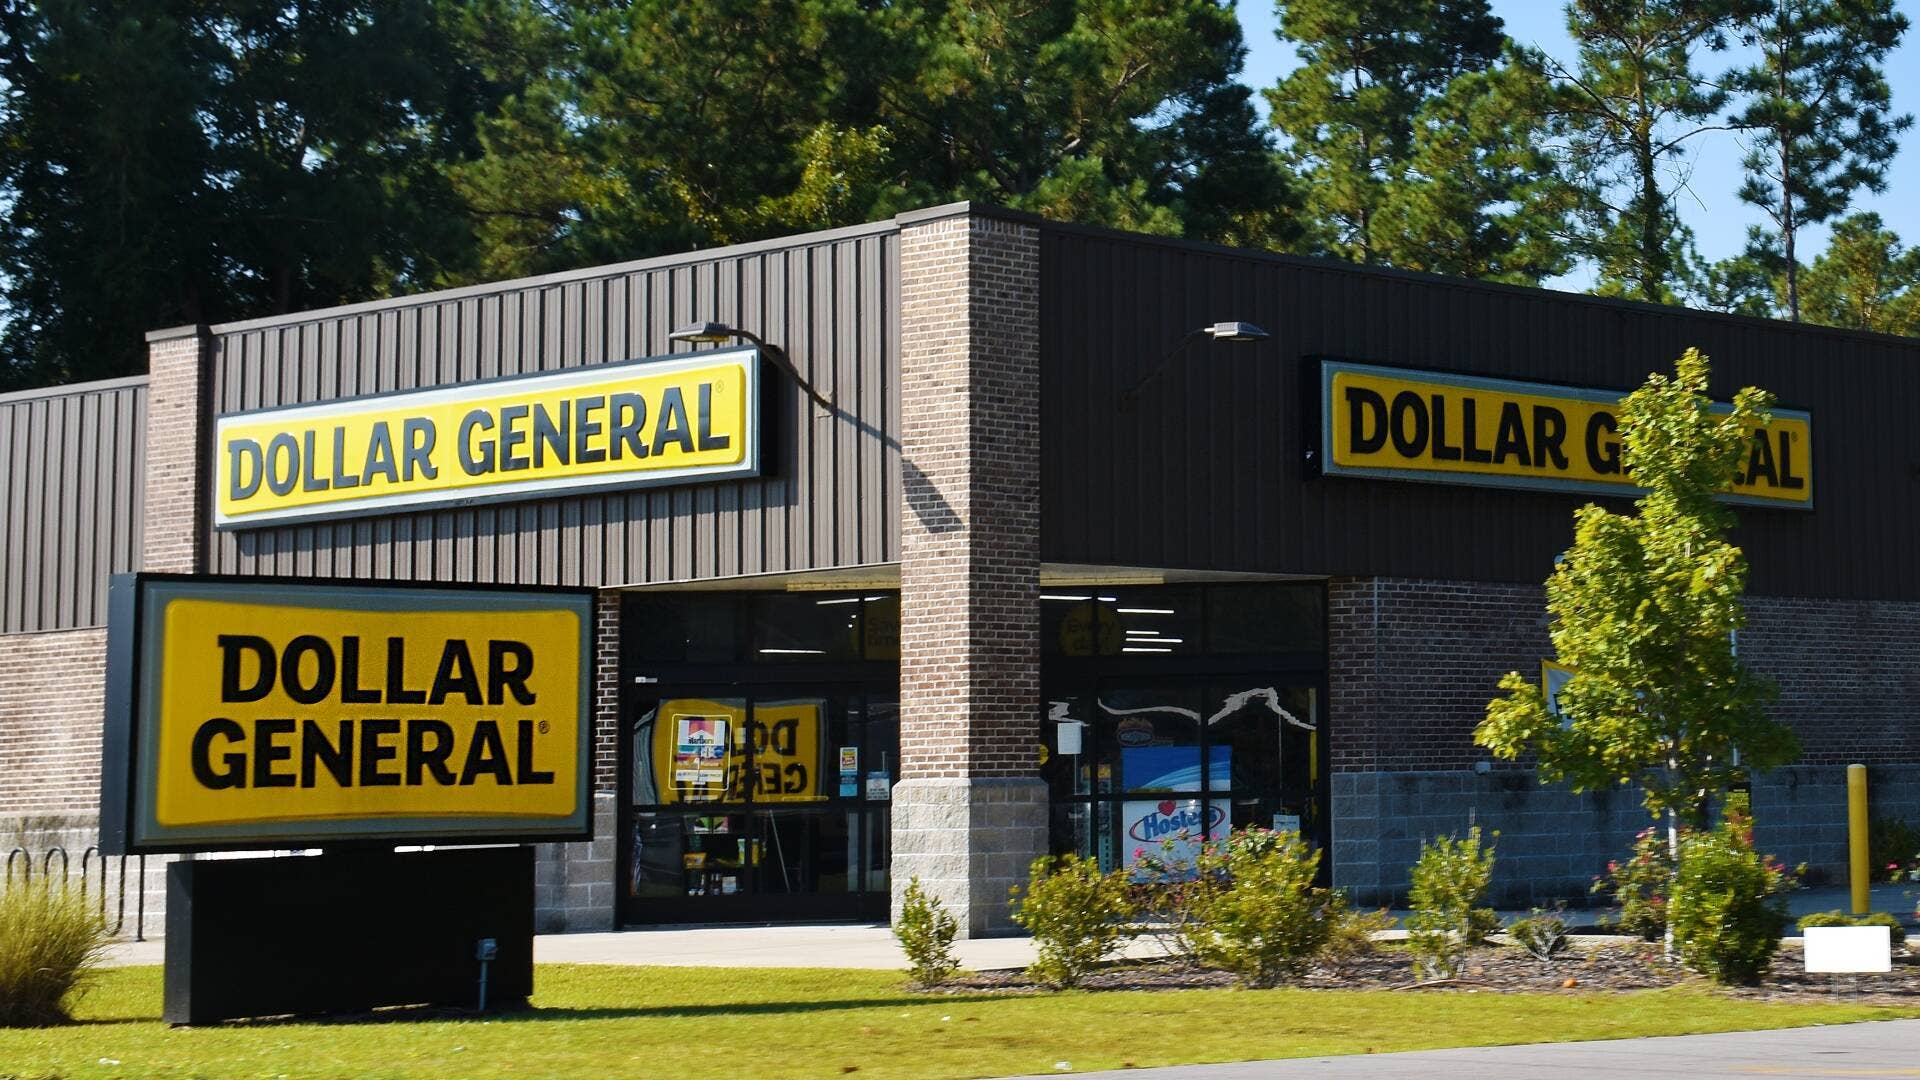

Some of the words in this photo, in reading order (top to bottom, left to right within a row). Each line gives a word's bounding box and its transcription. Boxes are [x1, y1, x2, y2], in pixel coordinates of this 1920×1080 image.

[228, 415, 439, 502] DOLLAR
[457, 383, 730, 477] GENERAL
[1344, 386, 1569, 471] DOLLAR
[217, 634, 537, 706] DOLLAR
[191, 717, 555, 791] GENERAL
